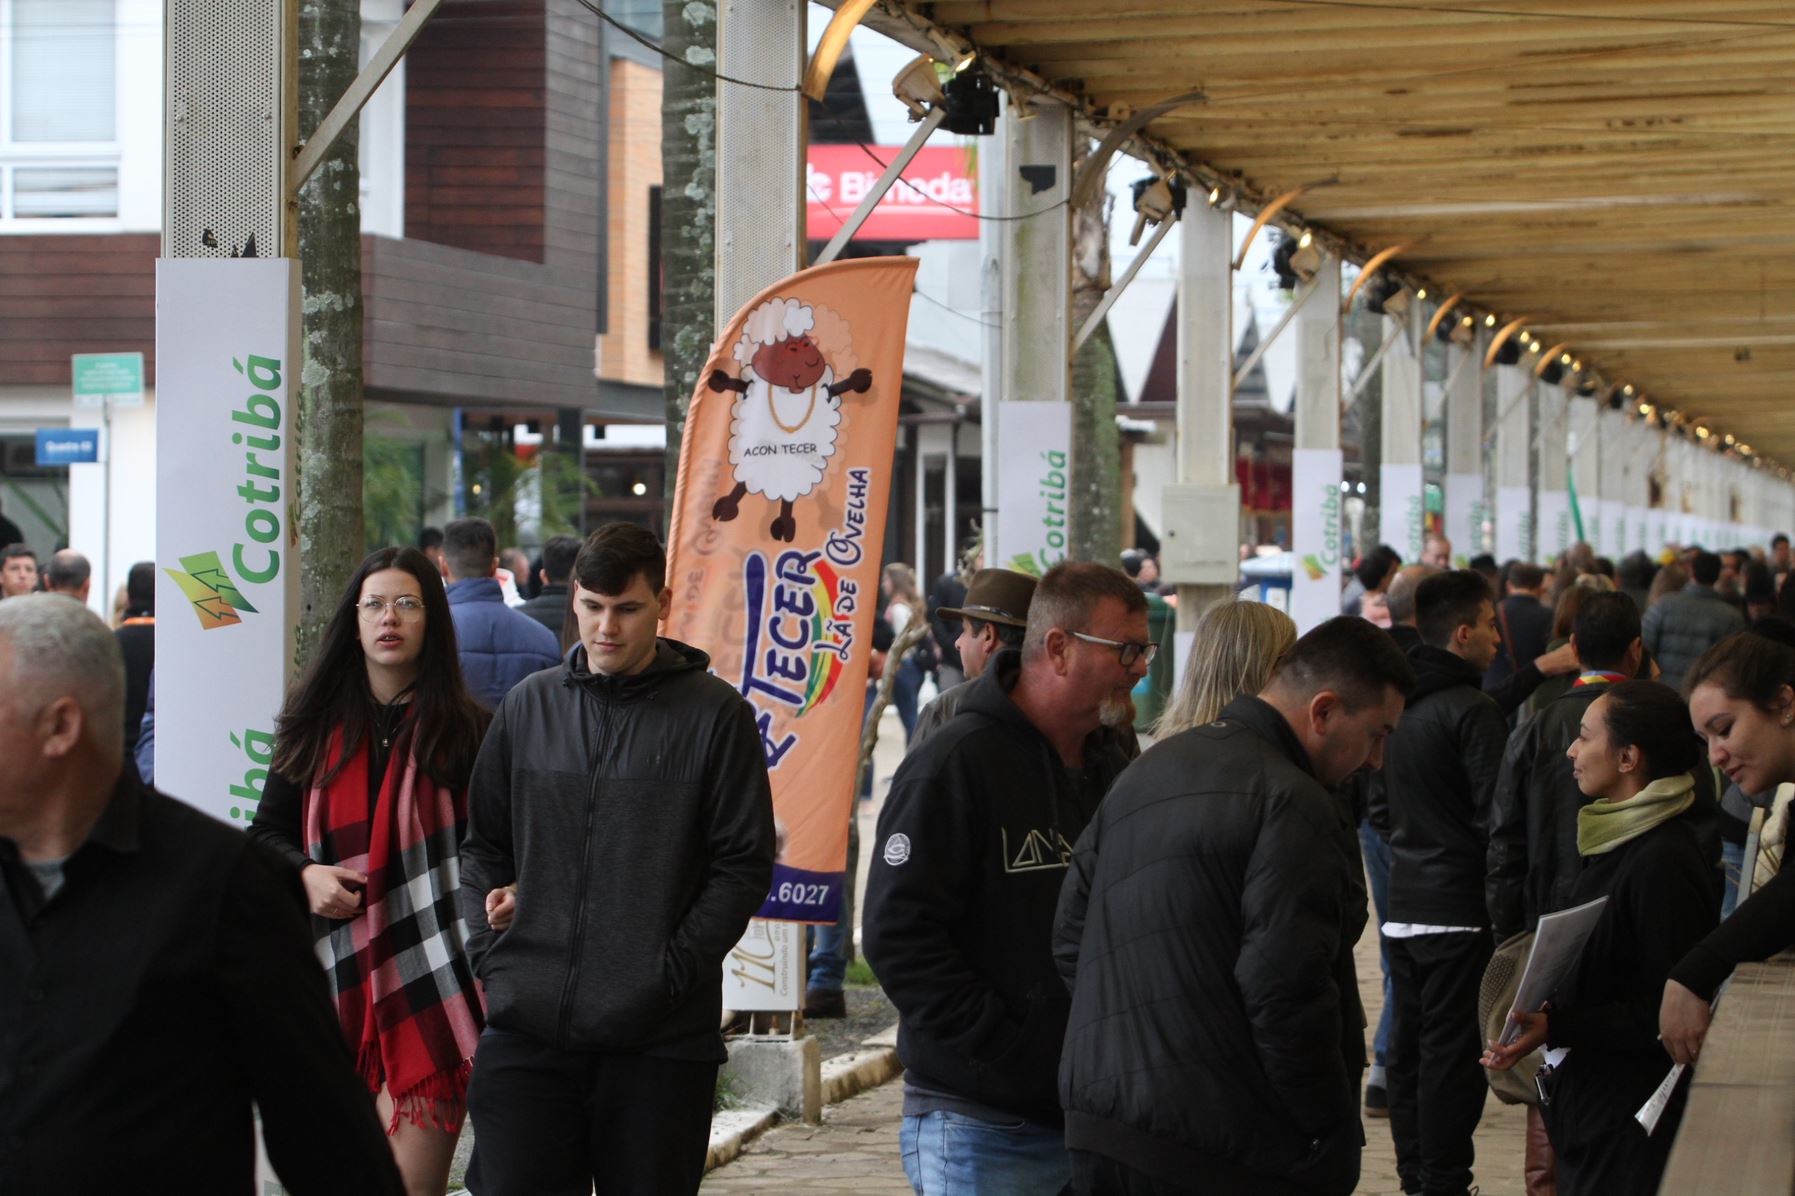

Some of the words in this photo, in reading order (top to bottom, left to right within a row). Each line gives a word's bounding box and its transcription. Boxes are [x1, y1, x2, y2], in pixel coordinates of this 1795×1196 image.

[231, 353, 282, 584] Cotribá
[743, 445, 778, 457] ACON
[781, 443, 818, 455] TECER
[1040, 449, 1067, 573] Cotribá
[740, 551, 822, 705] TECER
[837, 578, 857, 613] DE
[766, 881, 830, 905] .6027
